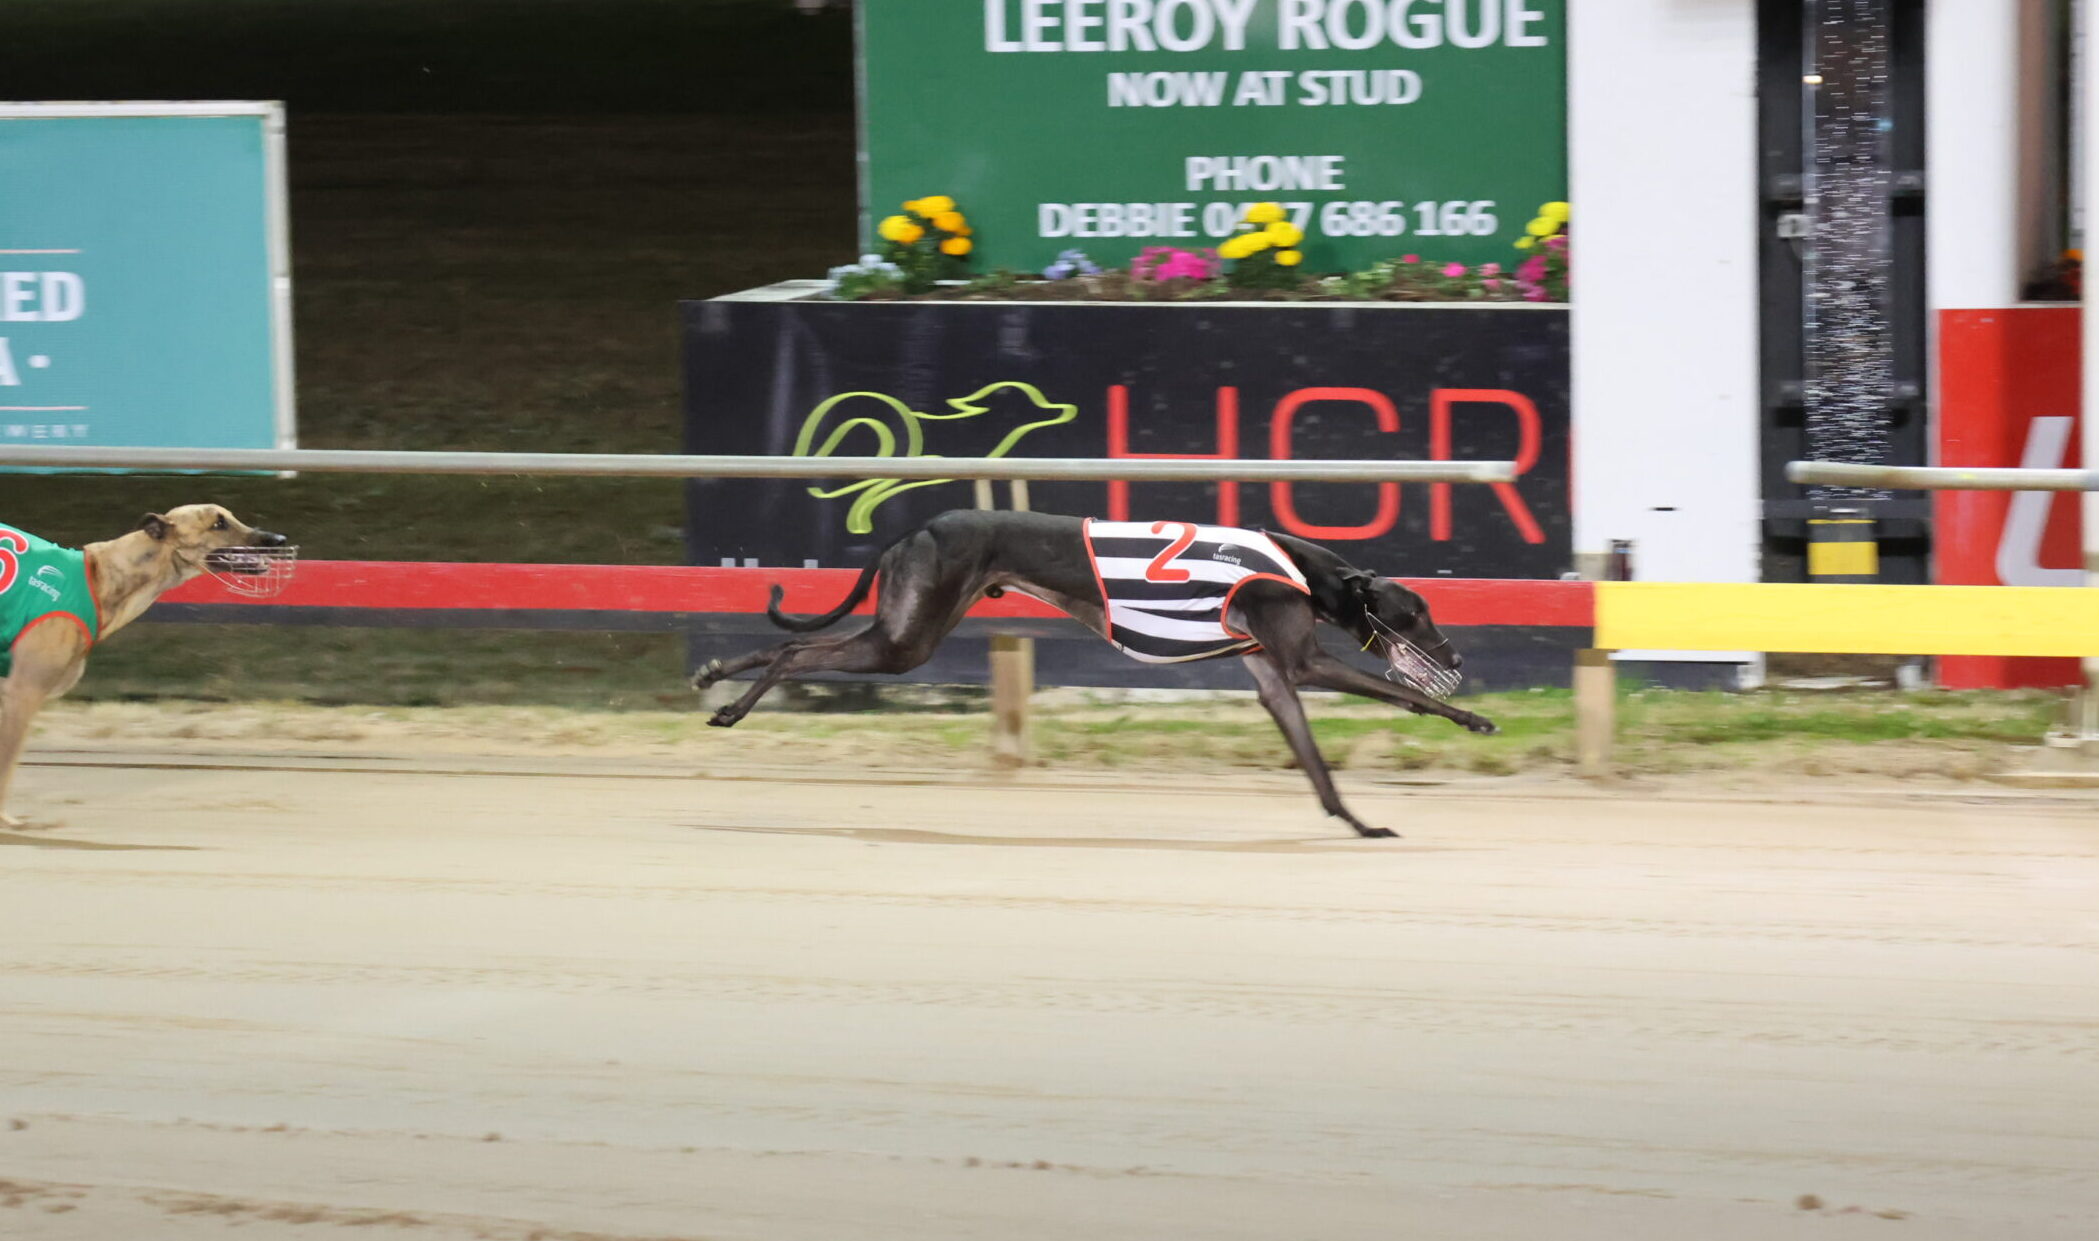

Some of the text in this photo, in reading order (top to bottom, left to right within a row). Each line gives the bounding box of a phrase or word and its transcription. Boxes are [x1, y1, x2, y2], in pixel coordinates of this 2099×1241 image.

[985, 0, 1548, 52] LEEROY ROGUE
[1107, 69, 1422, 107] NOW AT STUD
[1186, 155, 1345, 191] PHONE
[1039, 202, 1197, 238] DEBBIE
[1320, 200, 1406, 237] 686
[1414, 200, 1498, 236] 166
[0, 271, 86, 322] ED
[1145, 520, 1198, 583] 2
